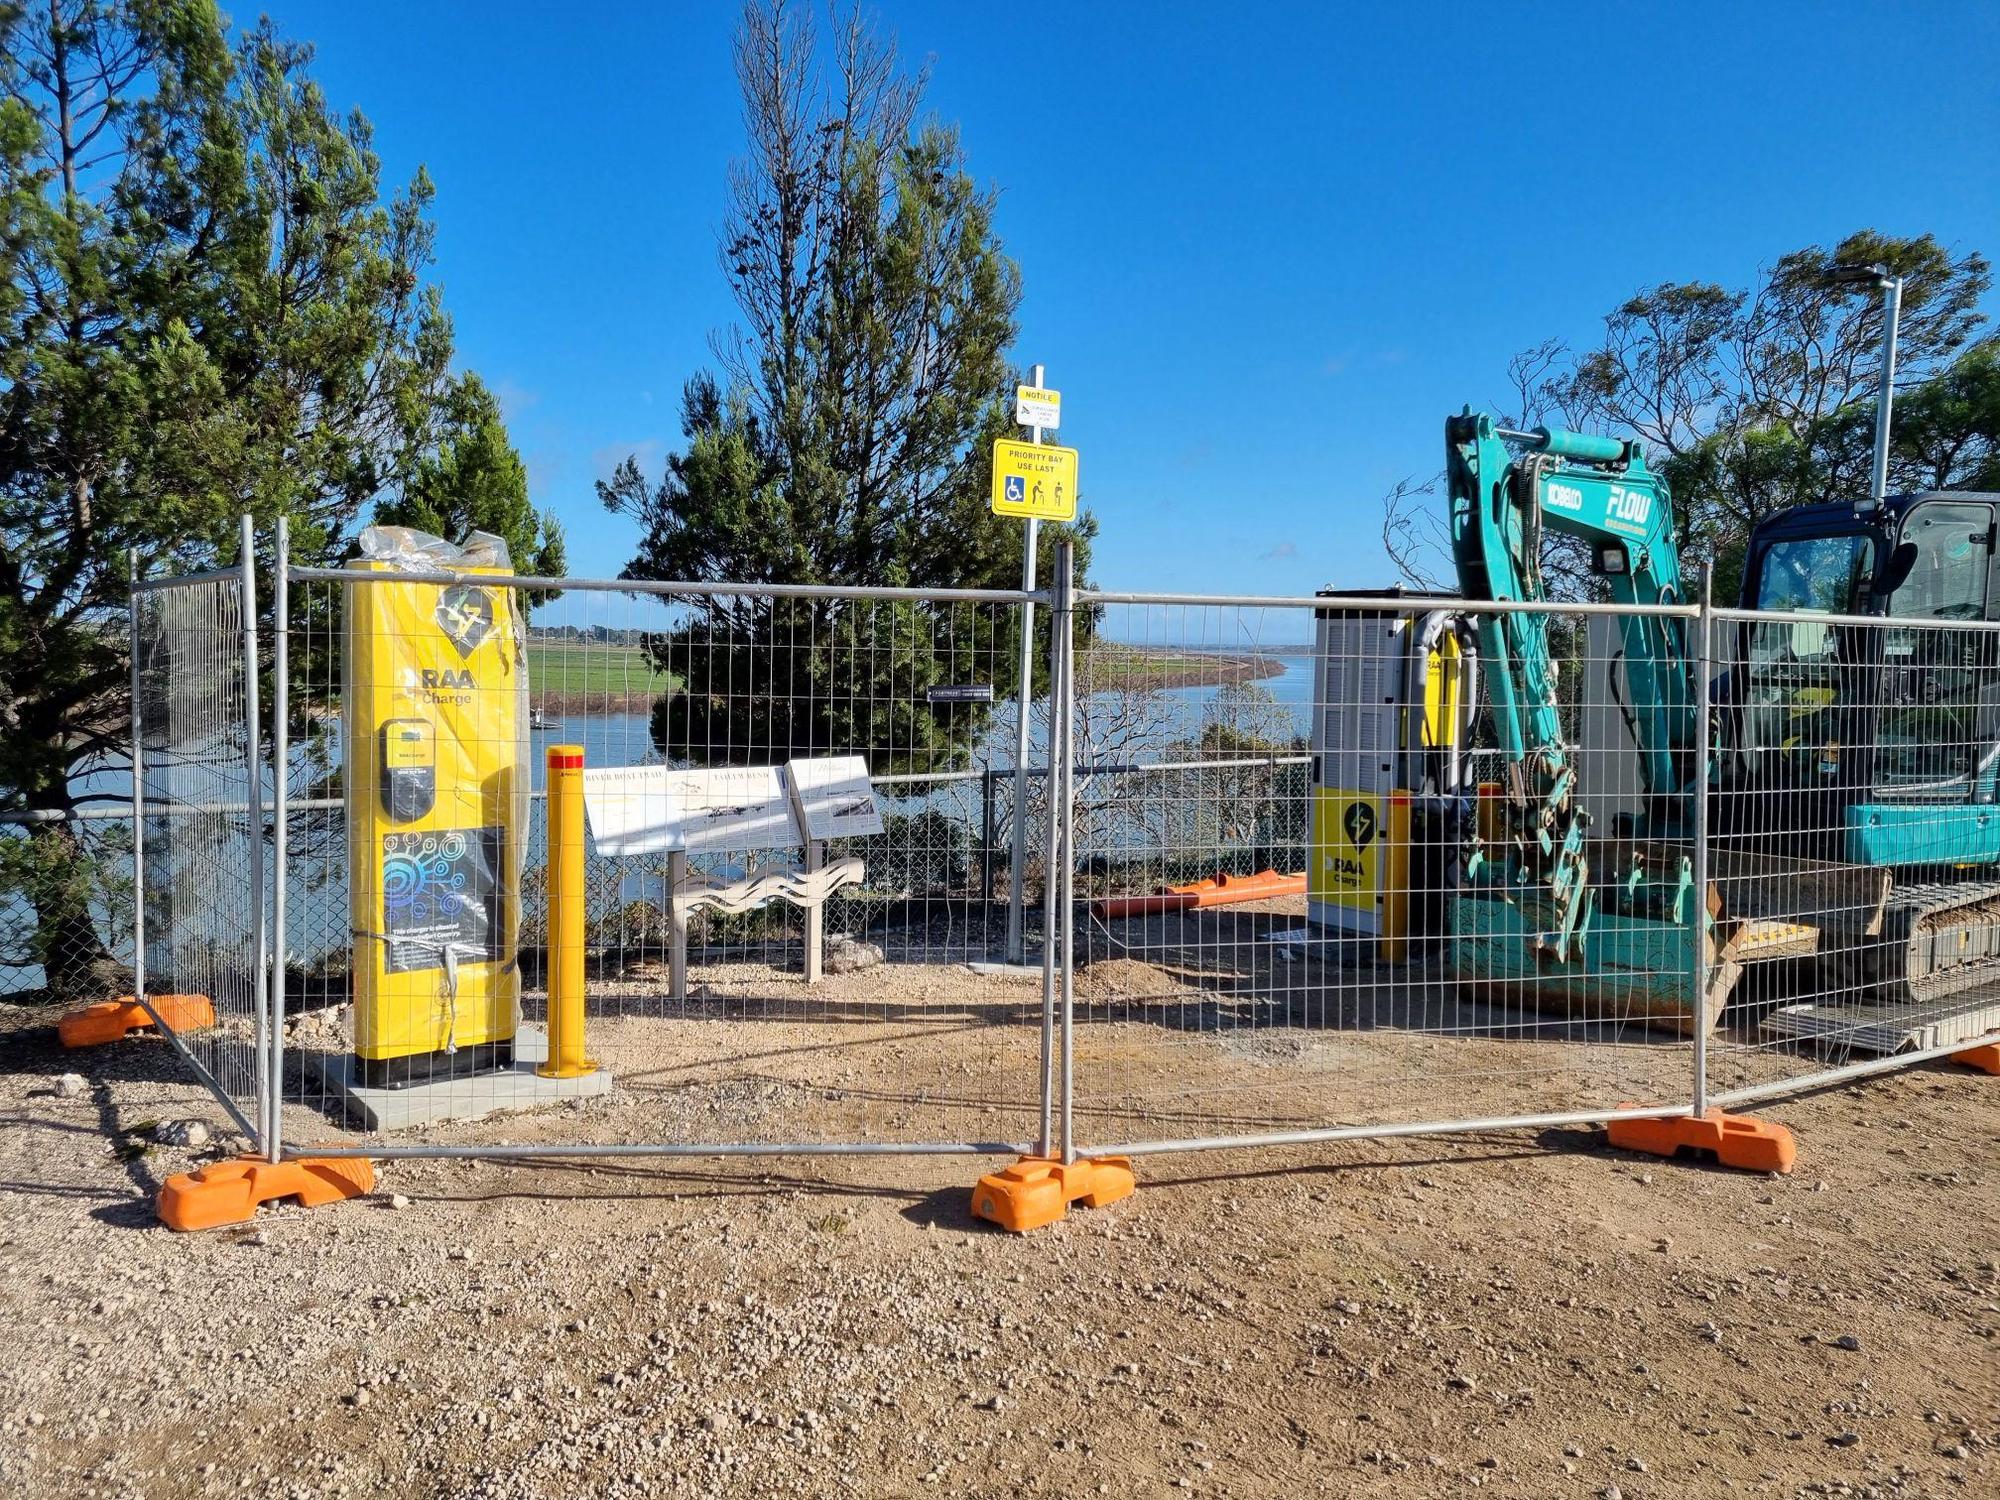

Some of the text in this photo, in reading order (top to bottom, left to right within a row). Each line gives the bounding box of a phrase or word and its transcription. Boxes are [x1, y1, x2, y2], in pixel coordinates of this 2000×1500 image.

[1025, 391, 1053, 402] NOTICE
[1009, 450, 1064, 464] PRIORITY BAY
[1017, 462, 1055, 473] USE LAST
[1605, 485, 1652, 524] FLOW
[421, 669, 475, 689] RAA
[421, 692, 472, 707] Charge
[1333, 858, 1365, 876] RAA
[1333, 874, 1363, 888] Charge
[392, 928, 406, 936] This
[406, 926, 429, 935] charger
[435, 921, 460, 931] situated
